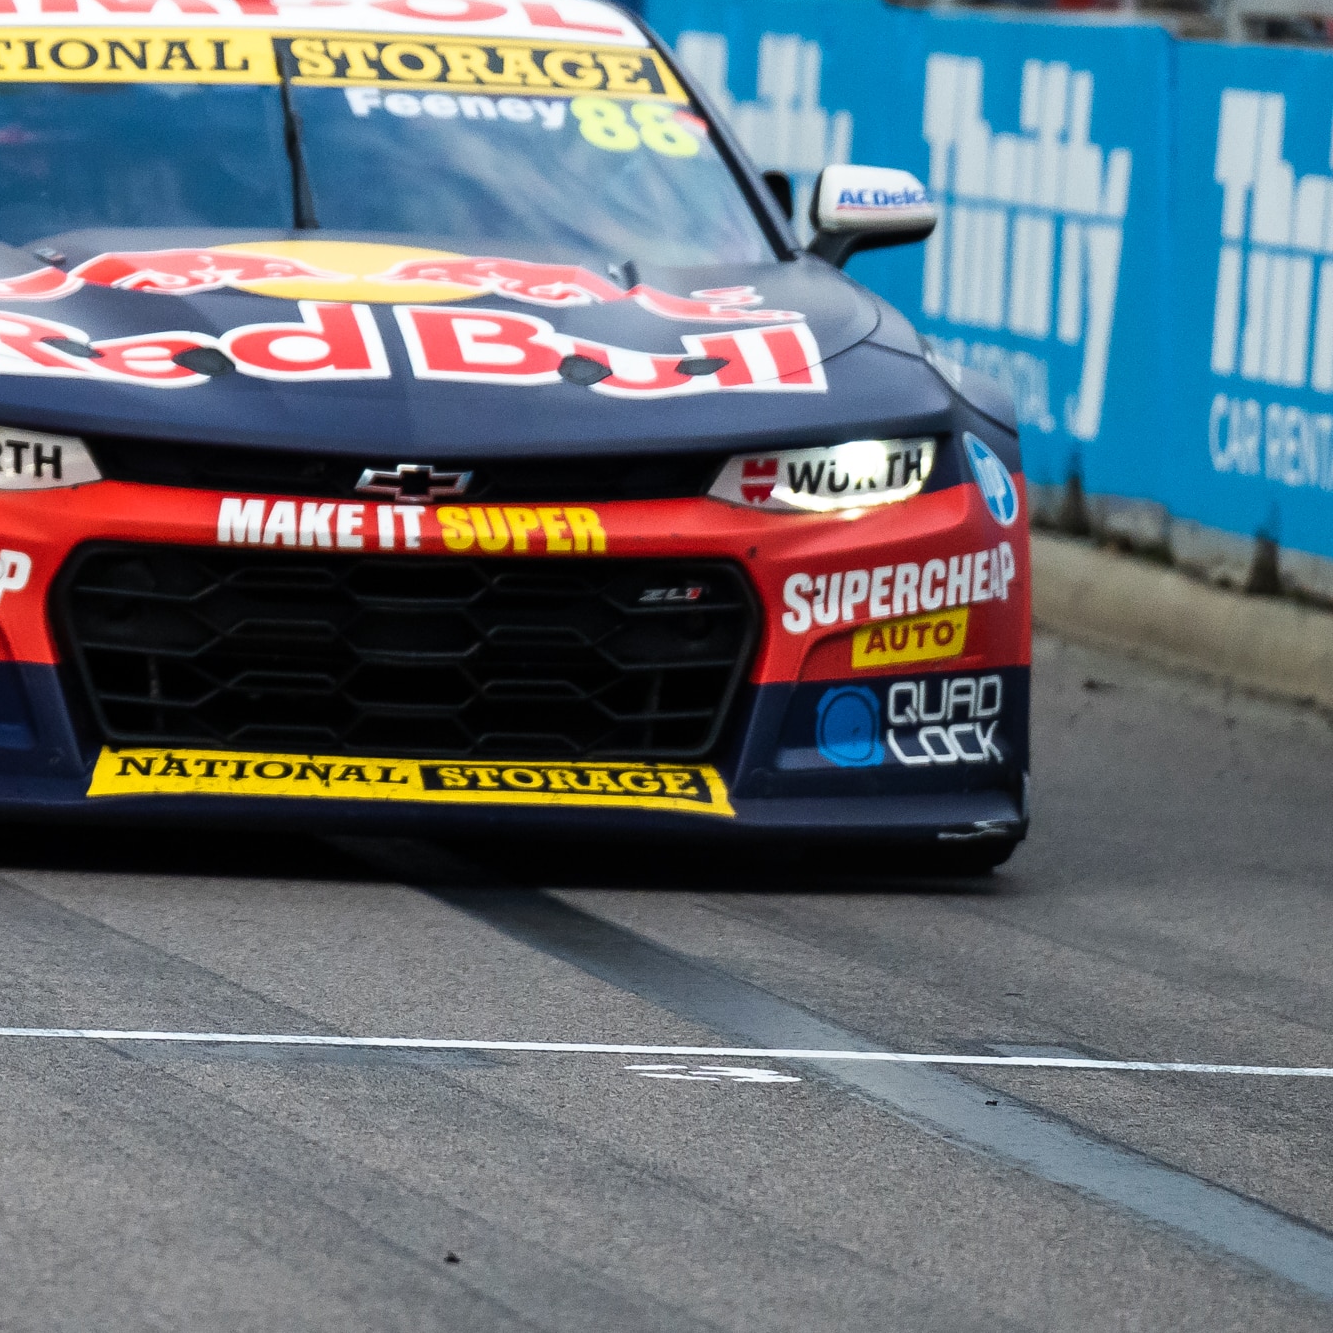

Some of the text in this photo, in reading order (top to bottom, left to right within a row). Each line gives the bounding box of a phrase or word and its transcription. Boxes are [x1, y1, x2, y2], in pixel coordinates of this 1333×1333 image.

[289, 37, 654, 96] STORAGE
[344, 88, 567, 130] Feeney
[394, 303, 828, 399] Bull
[788, 448, 923, 495] WÜTH
[217, 498, 608, 553] MAKE IT SUPER
[782, 541, 1017, 634] SUPERCHEAP
[863, 622, 957, 654] AUTO
[888, 674, 1002, 725] QUAD
[886, 722, 1004, 765] LOCK
[115, 754, 700, 799] NATIONAL STORAGE
